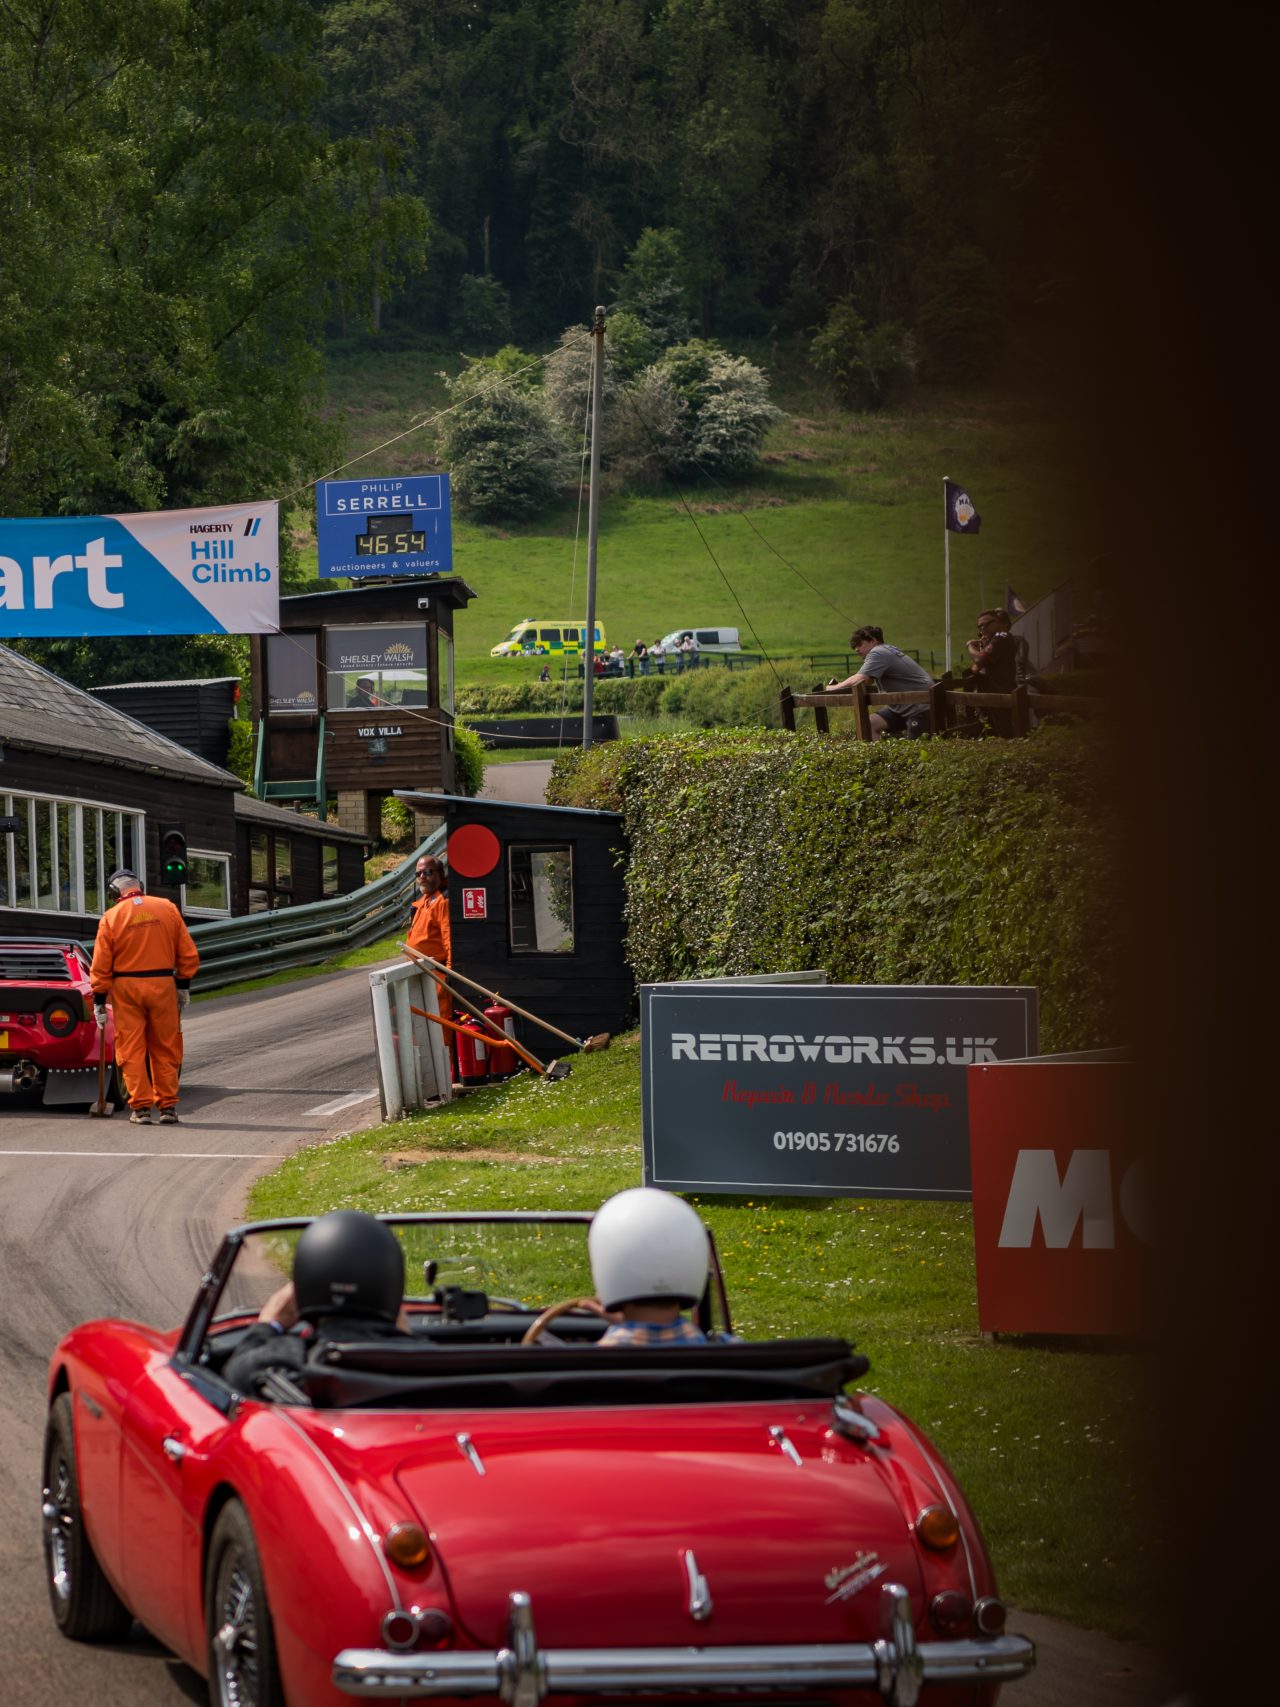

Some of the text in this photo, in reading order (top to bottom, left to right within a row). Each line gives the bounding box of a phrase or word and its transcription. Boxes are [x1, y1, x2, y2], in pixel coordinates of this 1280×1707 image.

[361, 482, 403, 493] PHILIP
[337, 494, 427, 511] SERRELL
[189, 523, 233, 534] HAGERTY
[191, 539, 234, 560] Hill
[192, 561, 271, 584] Climb
[330, 558, 441, 572] auctioneers & valuers
[340, 651, 414, 664] SHELSLEY WALSH
[358, 726, 402, 737] VOX VILLA
[671, 1033, 998, 1065] RETROWORKS.UK
[773, 1131, 900, 1154] 01905 731676
